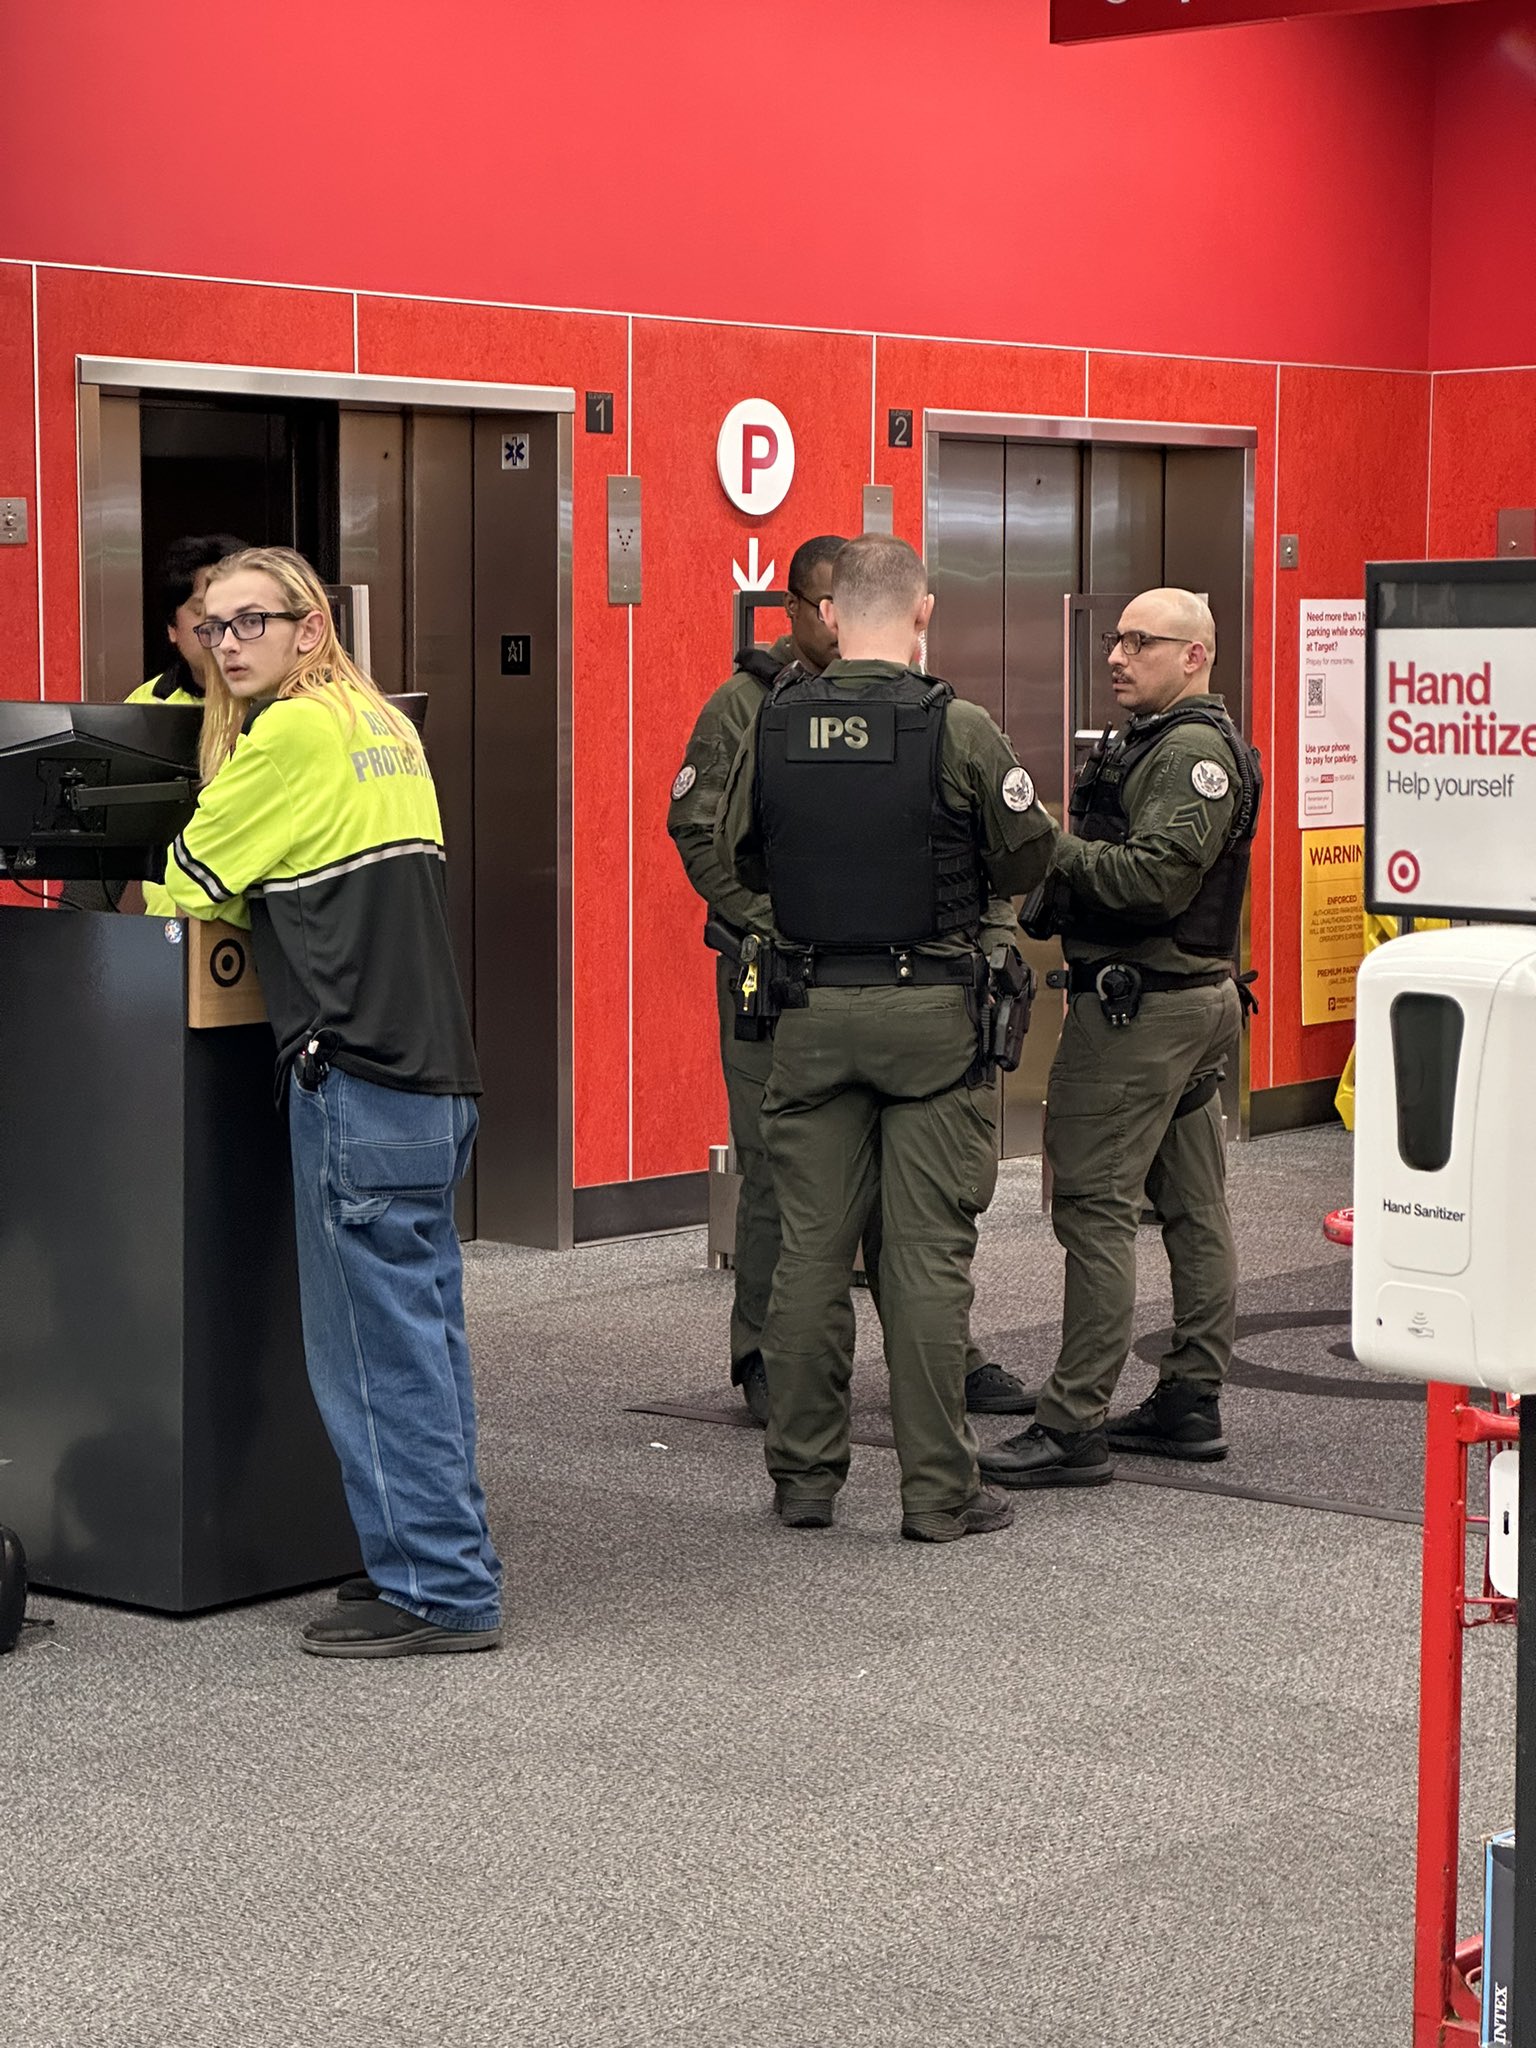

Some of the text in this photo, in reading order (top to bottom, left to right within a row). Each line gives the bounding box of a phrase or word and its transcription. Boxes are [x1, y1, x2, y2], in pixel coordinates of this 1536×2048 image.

[595, 400, 605, 431] 1
[894, 416, 907, 445] 2
[742, 423, 778, 494] P
[1307, 611, 1324, 621] Need
[1325, 613, 1341, 621] more
[1343, 611, 1357, 621] than
[1307, 627, 1330, 638] parking
[1331, 626, 1348, 636] while
[1306, 641, 1338, 653] at Target?
[1389, 661, 1491, 706] Hand
[810, 716, 869, 749] IPS
[1387, 710, 1536, 757] Sanitize
[1305, 743, 1350, 754] Use your phone
[1305, 753, 1358, 766] to pay for parking.
[1387, 770, 1515, 801] Help yourself
[1327, 894, 1357, 905] ENFORCED
[1317, 967, 1342, 978] PREMIUM
[1383, 1199, 1465, 1222] Hand Sanitizer
